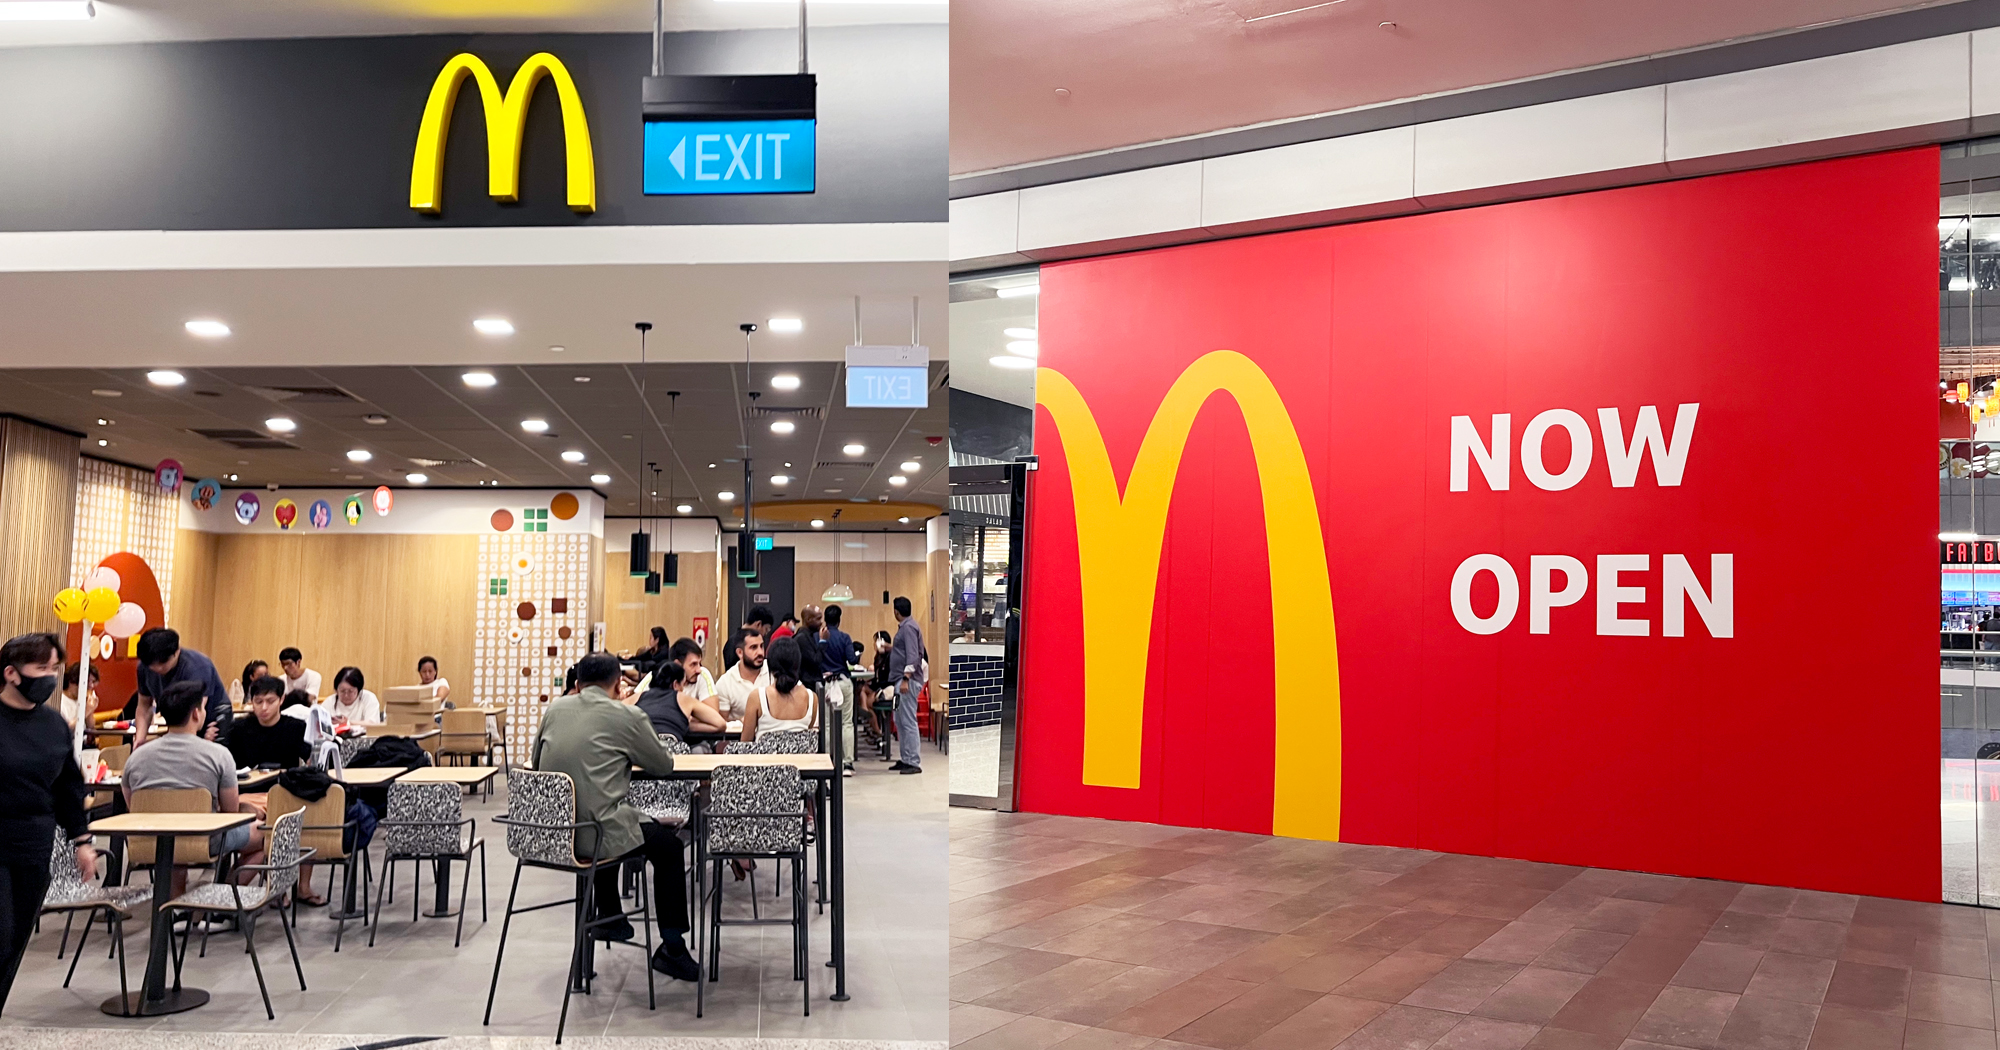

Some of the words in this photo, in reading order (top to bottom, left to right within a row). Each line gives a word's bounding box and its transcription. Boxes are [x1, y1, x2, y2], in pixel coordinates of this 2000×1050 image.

[695, 133, 791, 181] EXIT
[1449, 402, 1700, 492] NOW
[1946, 542, 2000, 562] FATB
[1450, 553, 1735, 638] OPEN
